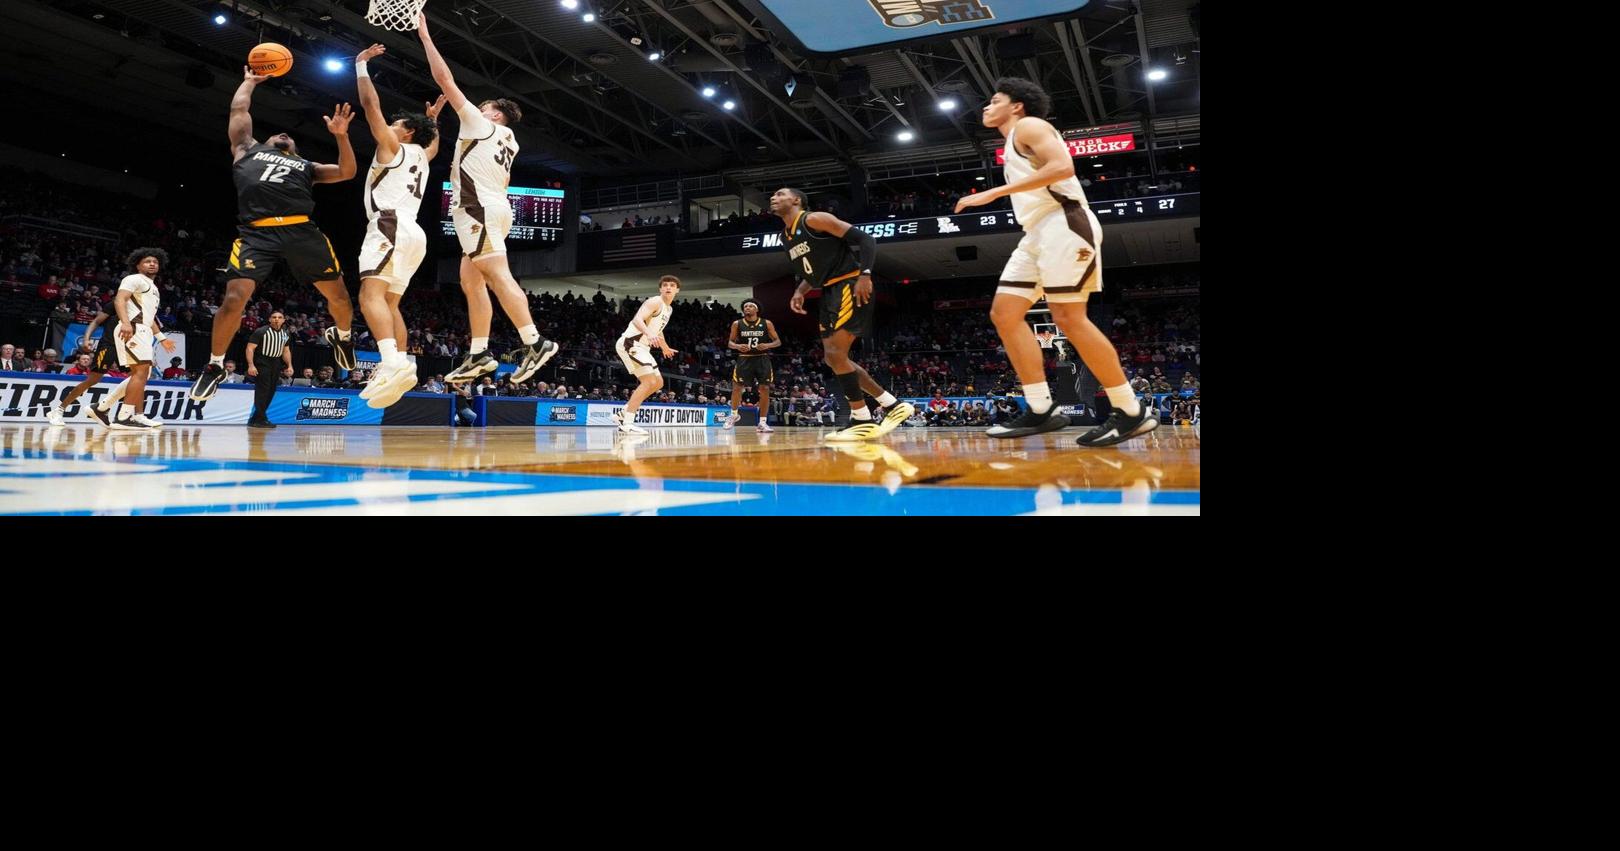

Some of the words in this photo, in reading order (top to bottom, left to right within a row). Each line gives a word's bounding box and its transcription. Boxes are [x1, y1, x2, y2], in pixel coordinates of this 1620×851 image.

[1069, 139, 1103, 147] NNOR
[1075, 142, 1120, 155] DECK
[253, 152, 306, 172] PANTHERS
[494, 139, 515, 173] 35
[260, 163, 291, 183] 12
[1158, 199, 1175, 209] 27
[980, 215, 996, 225] 23
[802, 256, 813, 275] 0
[747, 337, 759, 350] 13
[356, 361, 378, 369] MARC
[0, 383, 109, 418] IRST
[310, 399, 336, 408] MARCH
[311, 408, 347, 417] MADNESS
[664, 409, 675, 423] OF
[677, 409, 705, 423] DAYTON
